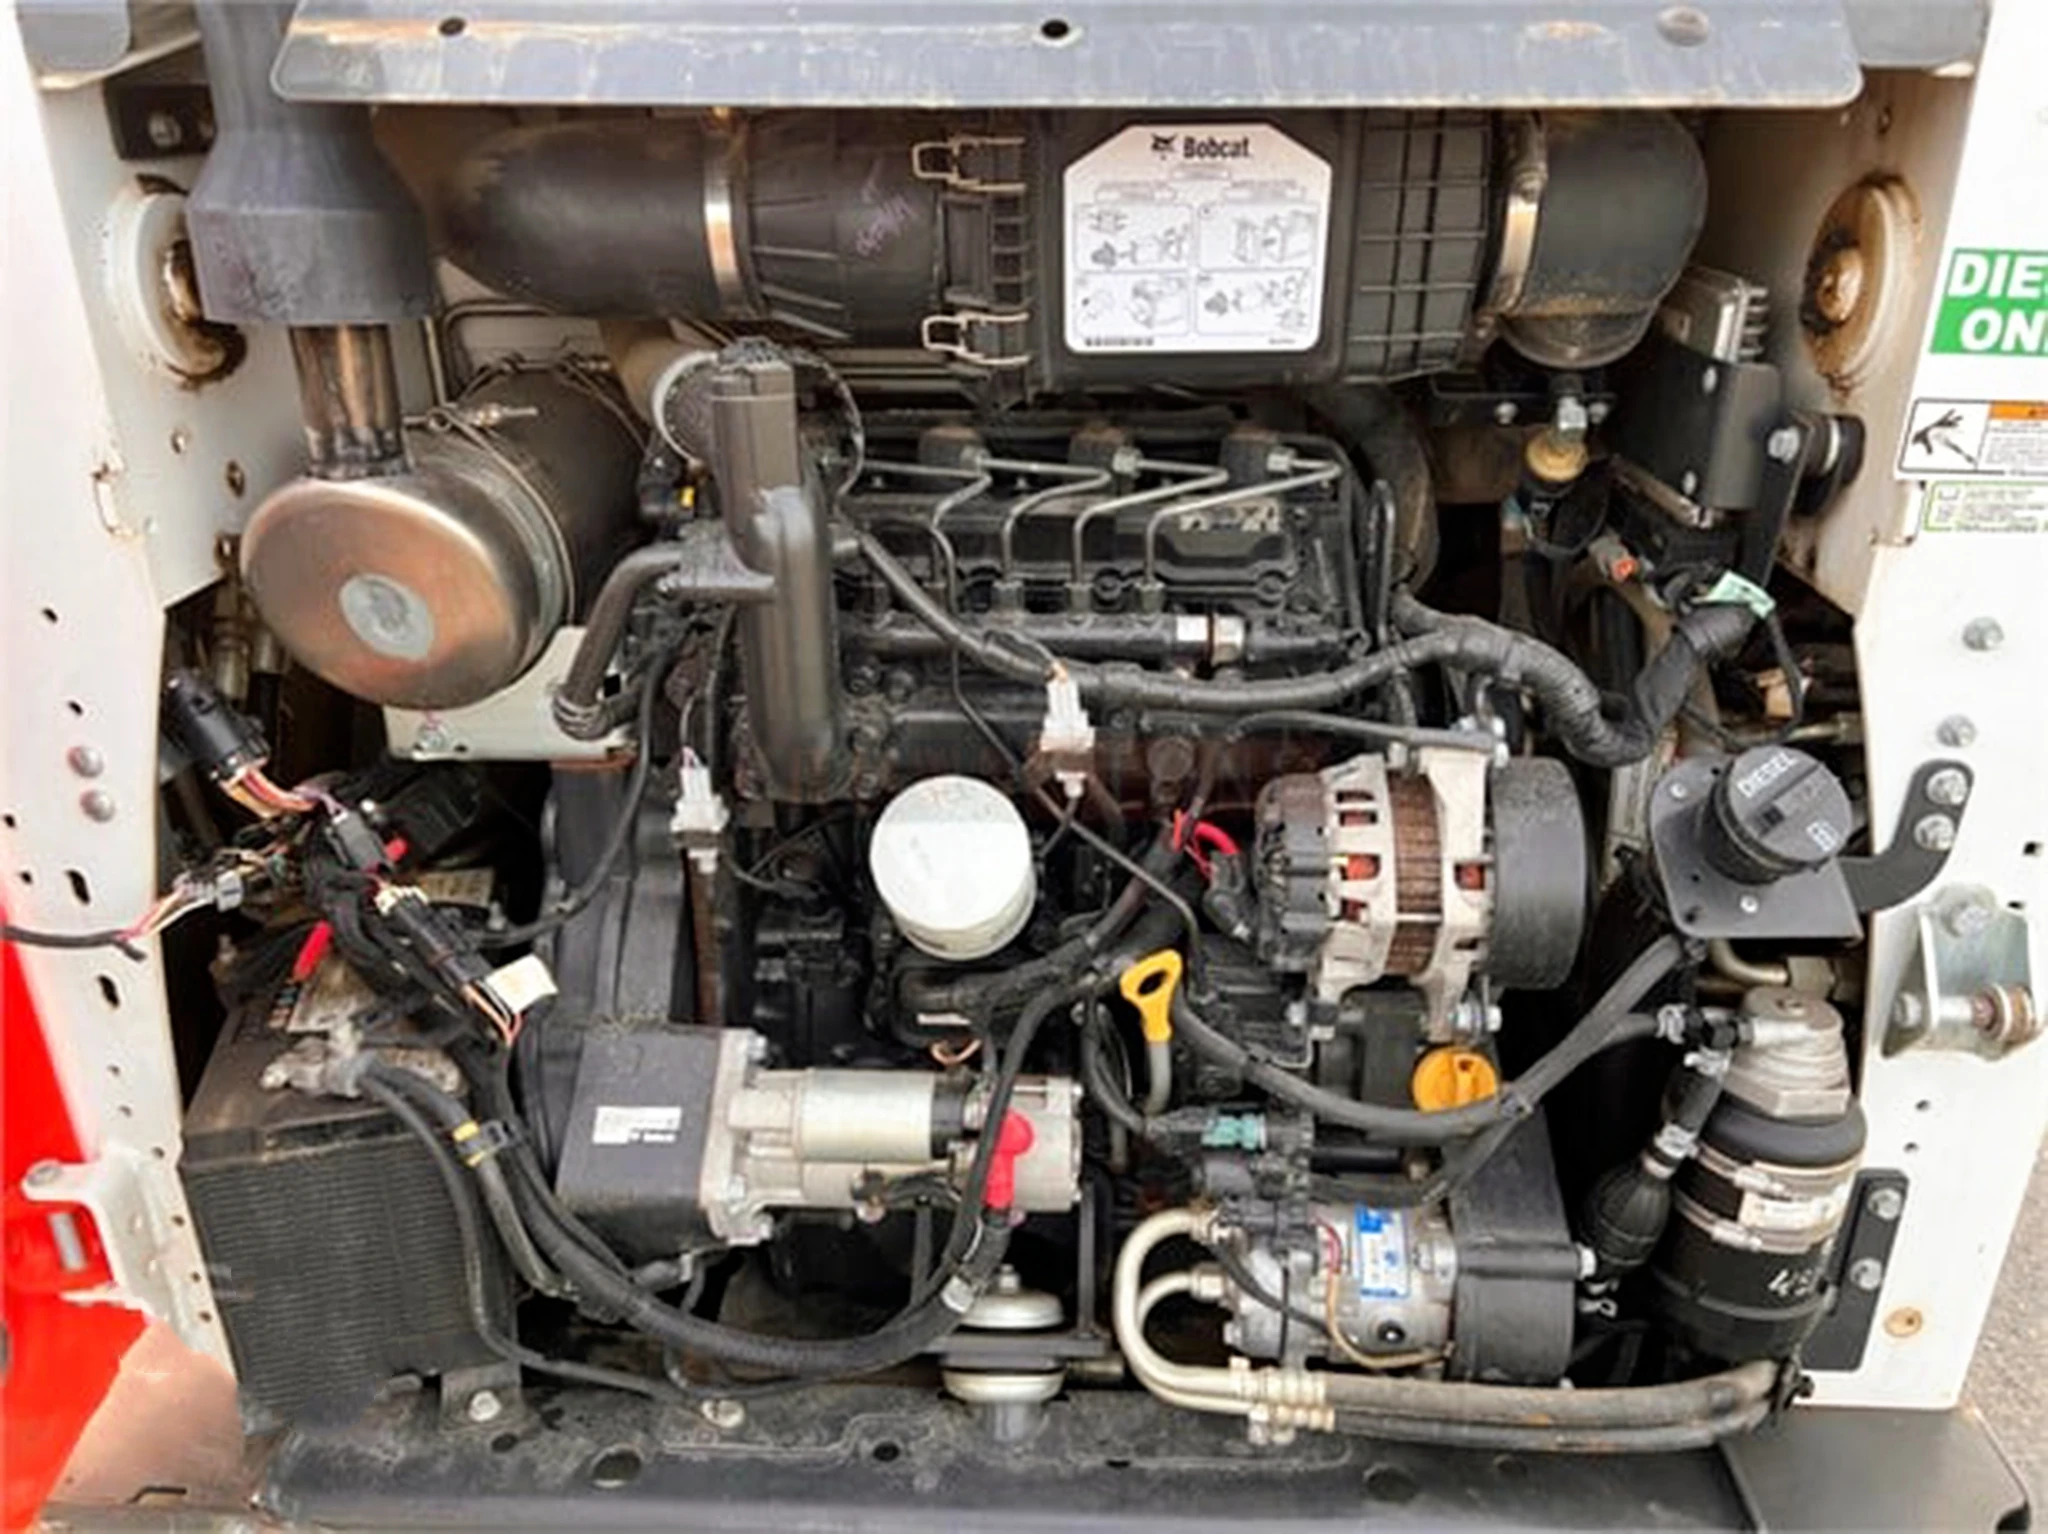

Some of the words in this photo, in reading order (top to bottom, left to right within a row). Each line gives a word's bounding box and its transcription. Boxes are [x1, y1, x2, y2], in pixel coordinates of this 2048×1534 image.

[1183, 135, 1249, 159] Bobcat
[1948, 254, 2048, 298] DIE
[1961, 309, 2048, 351] ON
